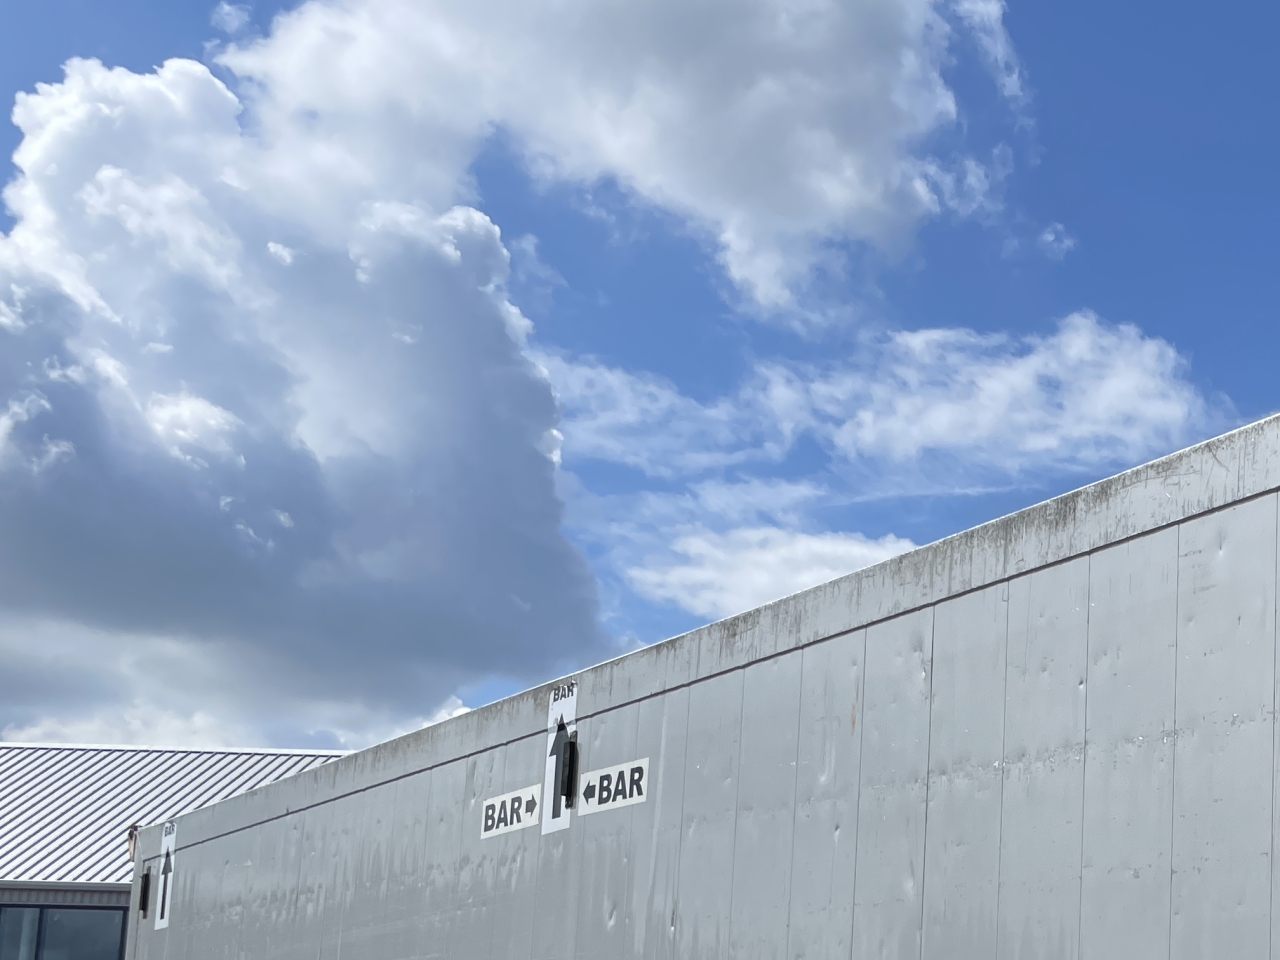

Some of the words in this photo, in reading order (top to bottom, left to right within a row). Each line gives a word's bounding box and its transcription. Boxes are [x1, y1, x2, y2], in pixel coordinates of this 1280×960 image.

[553, 683, 574, 702] BAR
[598, 766, 644, 806] BAR
[484, 796, 522, 832] BAR
